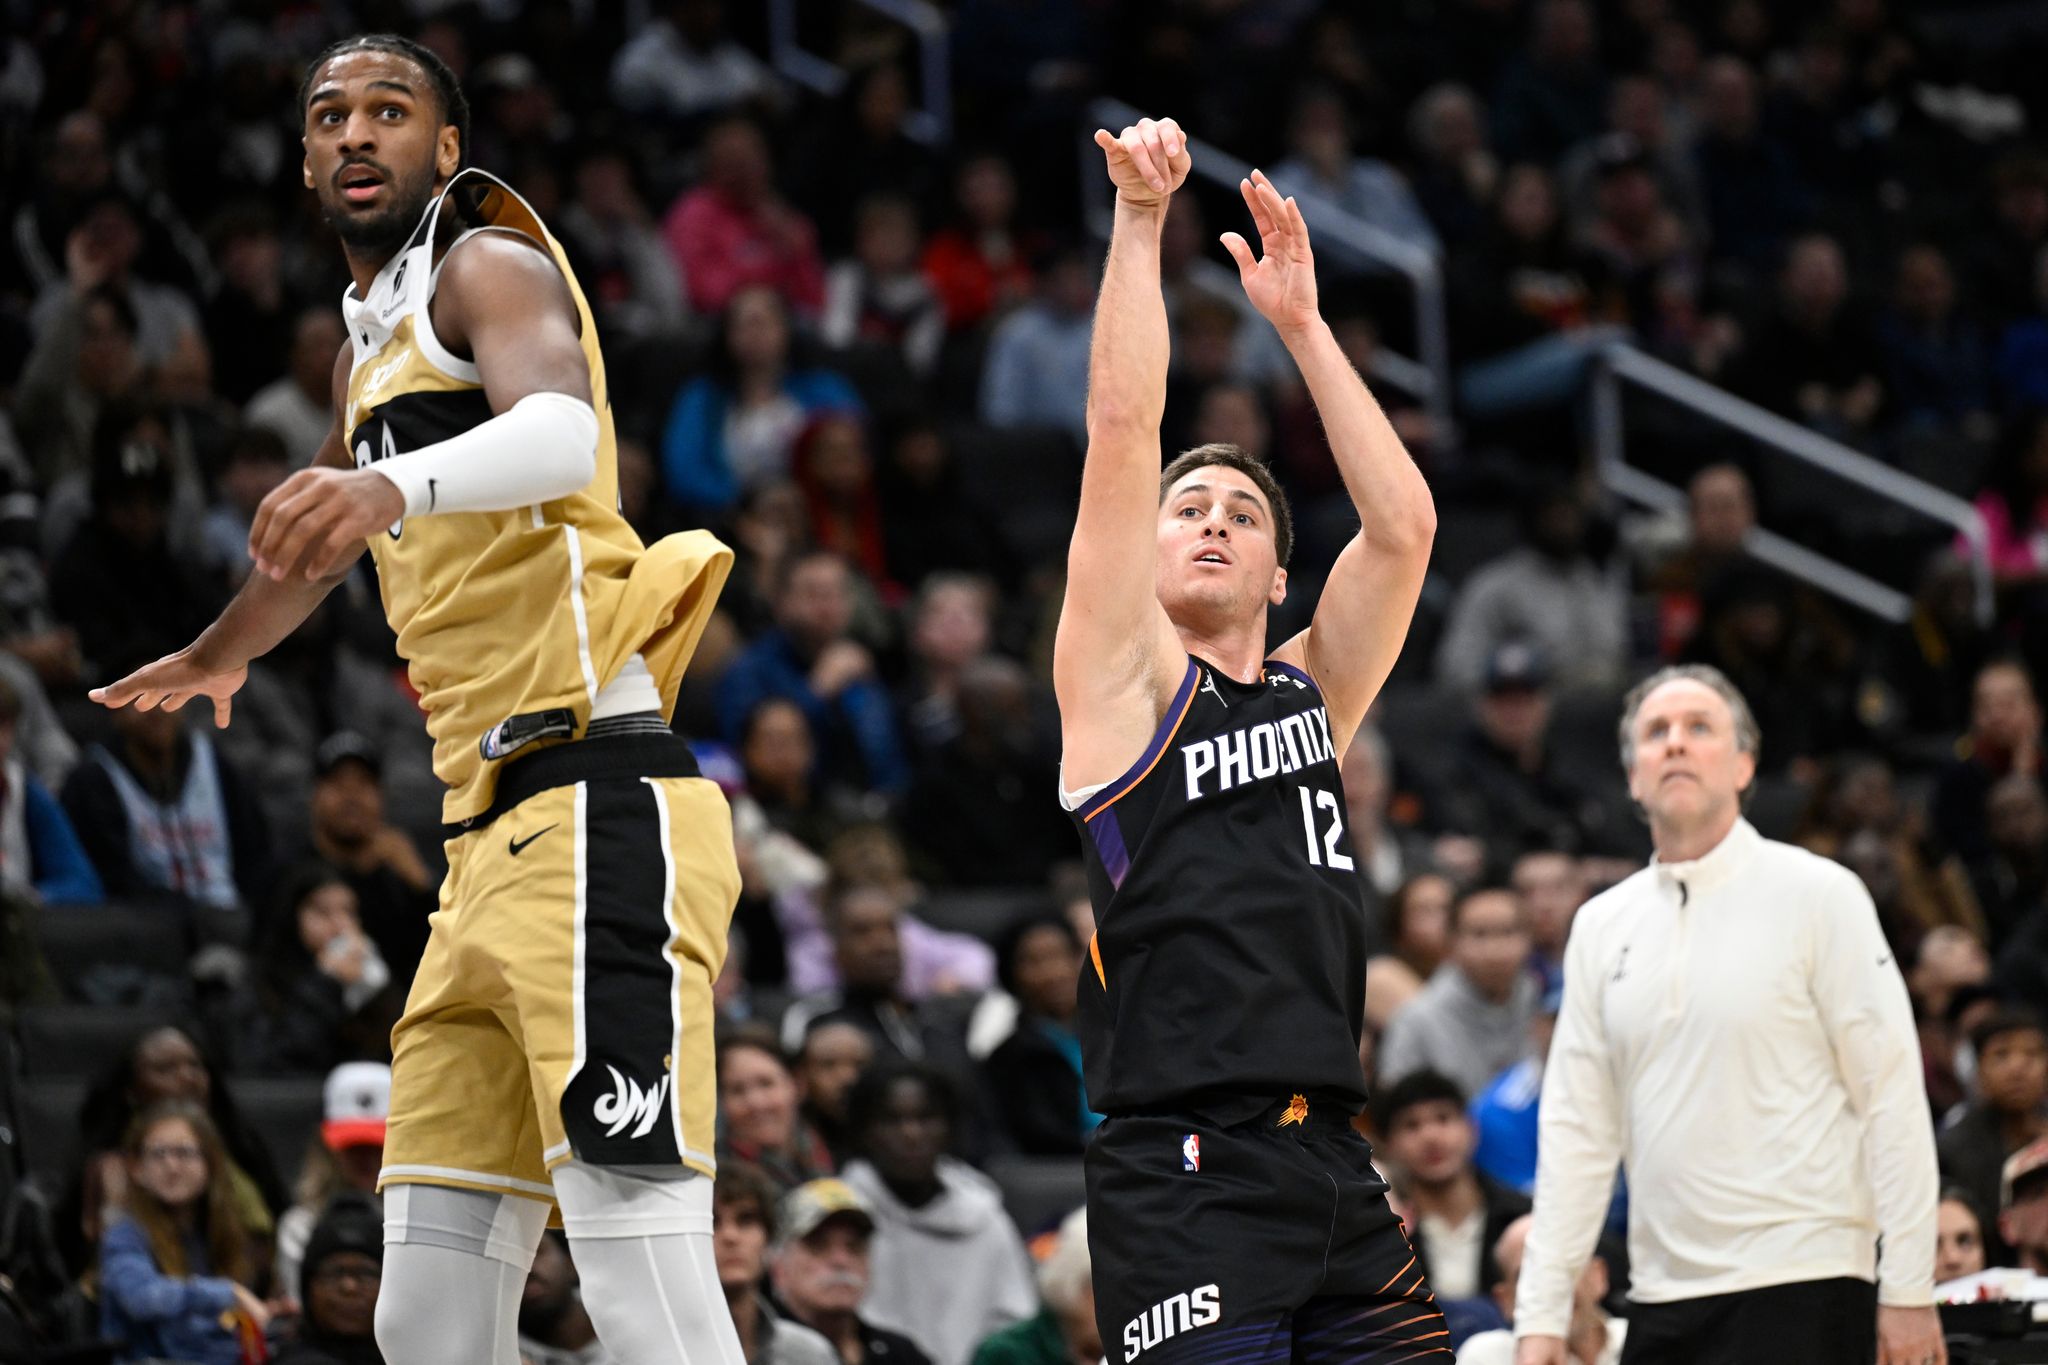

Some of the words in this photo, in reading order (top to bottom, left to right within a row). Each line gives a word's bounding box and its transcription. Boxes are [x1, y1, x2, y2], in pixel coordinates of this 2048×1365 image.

[1181, 706, 1336, 801] PHOENIX
[1298, 785, 1354, 872] 12
[1123, 1283, 1221, 1364] SUNS
